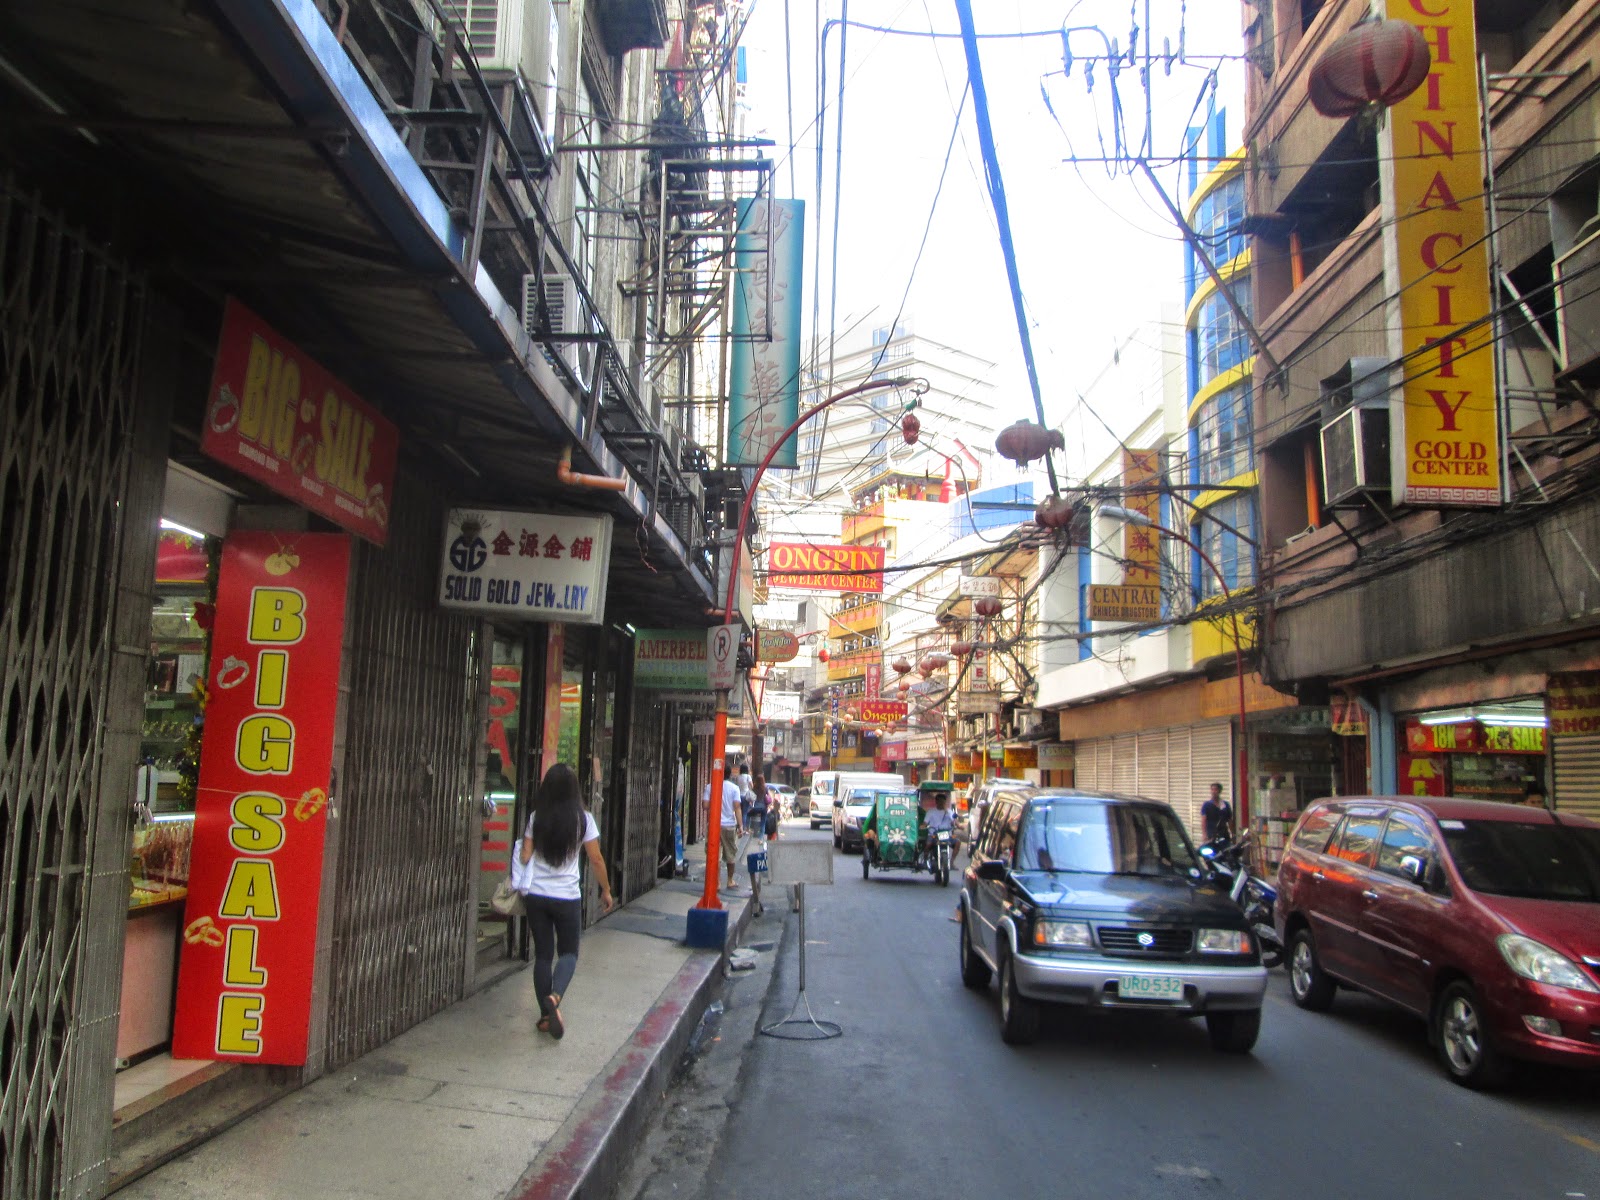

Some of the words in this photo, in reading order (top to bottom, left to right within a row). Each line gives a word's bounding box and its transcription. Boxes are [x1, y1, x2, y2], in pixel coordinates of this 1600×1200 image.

[1420, 232, 1473, 432] CITY
[237, 334, 300, 463] BIG
[314, 388, 375, 504] SALE
[1414, 440, 1487, 460] GOLD
[1412, 461, 1489, 476] CENTER
[773, 545, 880, 571] ONGPIN
[445, 574, 482, 601] SOLID
[487, 579, 521, 605] GOLD
[526, 582, 589, 611] JEWLRY
[773, 574, 829, 587] JEWELRY
[831, 575, 878, 589] CENTER
[1092, 588, 1158, 605] CENTRAL
[1092, 606, 1120, 617] CHINESE
[1121, 607, 1157, 618] DRUGSTORE
[234, 586, 307, 776] BIG
[1432, 725, 1456, 749] 18K
[1512, 727, 1544, 751] SALE
[215, 791, 287, 1057] SALE
